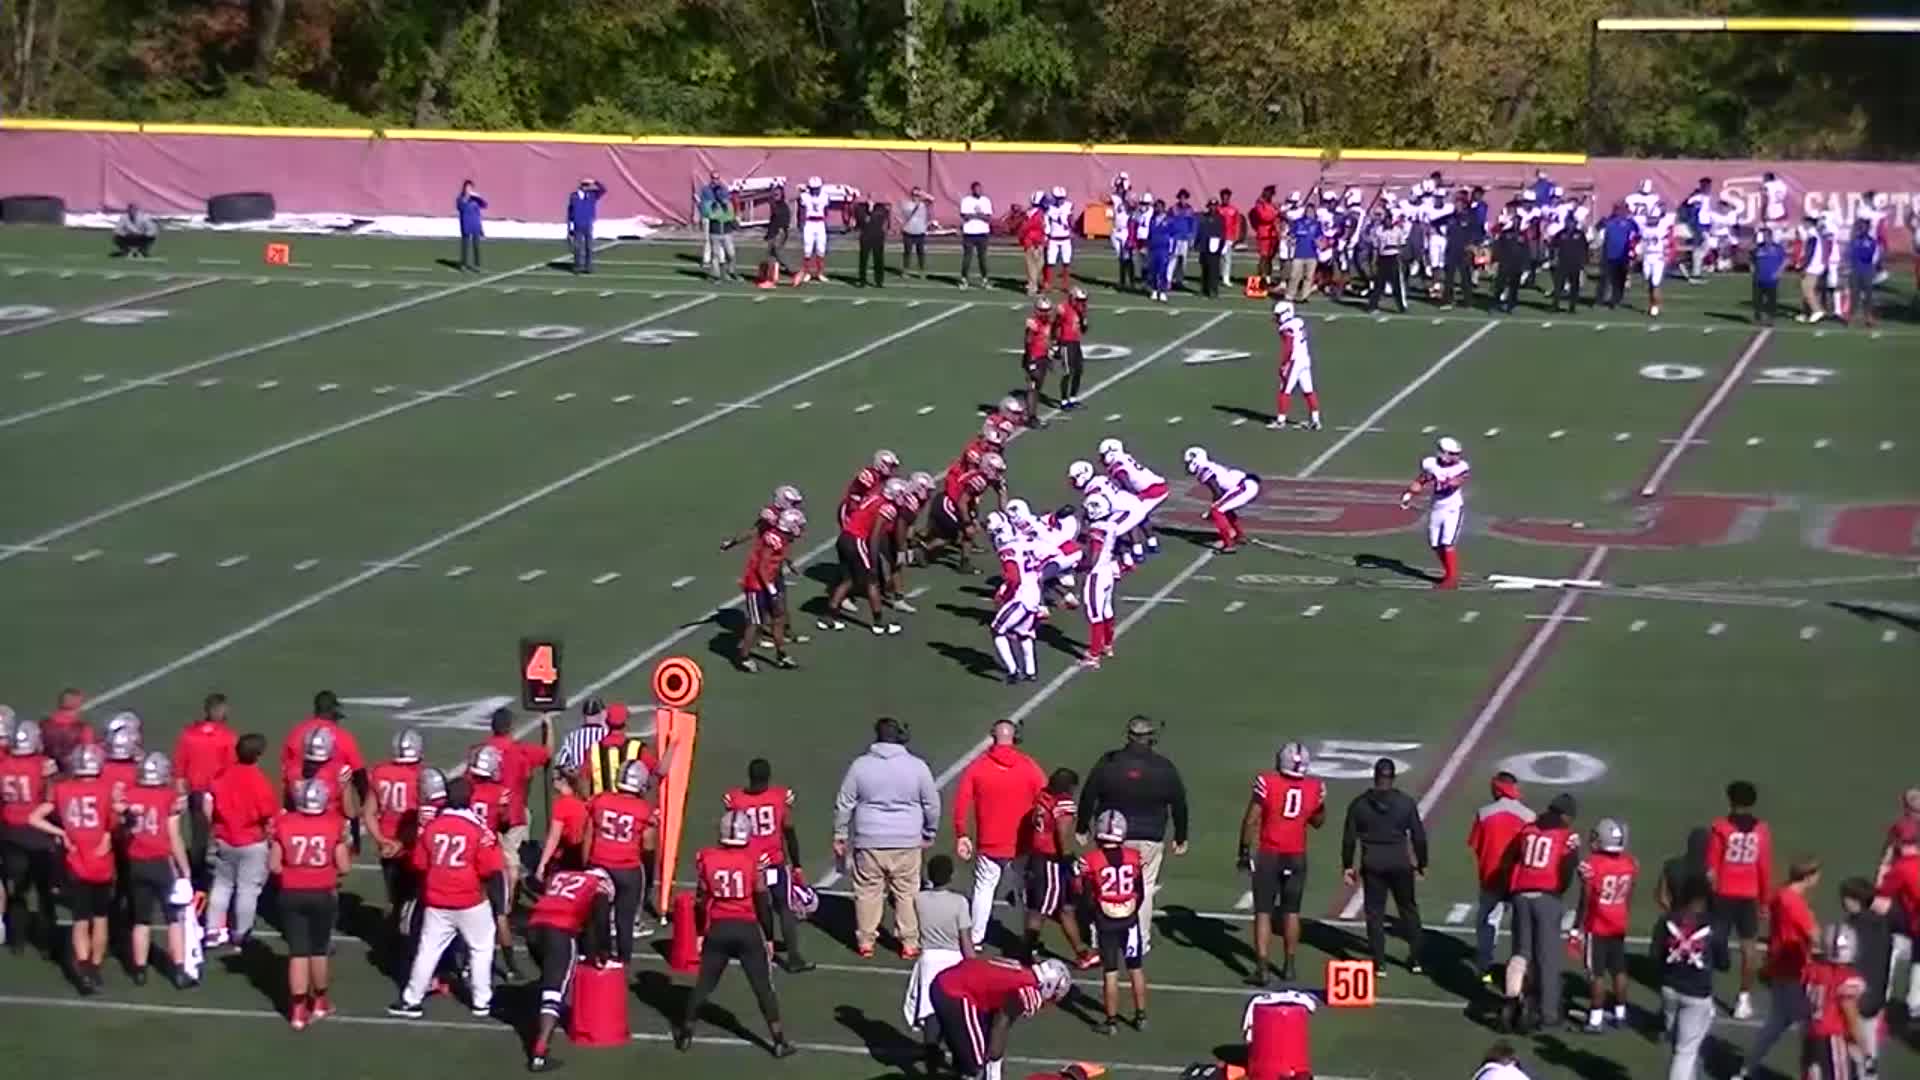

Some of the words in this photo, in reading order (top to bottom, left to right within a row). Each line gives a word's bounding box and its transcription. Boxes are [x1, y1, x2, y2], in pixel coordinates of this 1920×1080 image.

[525, 644, 559, 684] 4
[1, 775, 32, 803] 51
[378, 781, 408, 812] 70
[1283, 788, 1303, 818] 0
[66, 796, 99, 829] 45
[601, 810, 634, 843] 53
[291, 835, 327, 866] 73
[433, 834, 466, 867] 72
[1524, 836, 1553, 868] 10
[546, 873, 588, 899] 52
[713, 870, 745, 898] 31
[1100, 864, 1135, 896] 26
[1333, 967, 1368, 1001] 50
